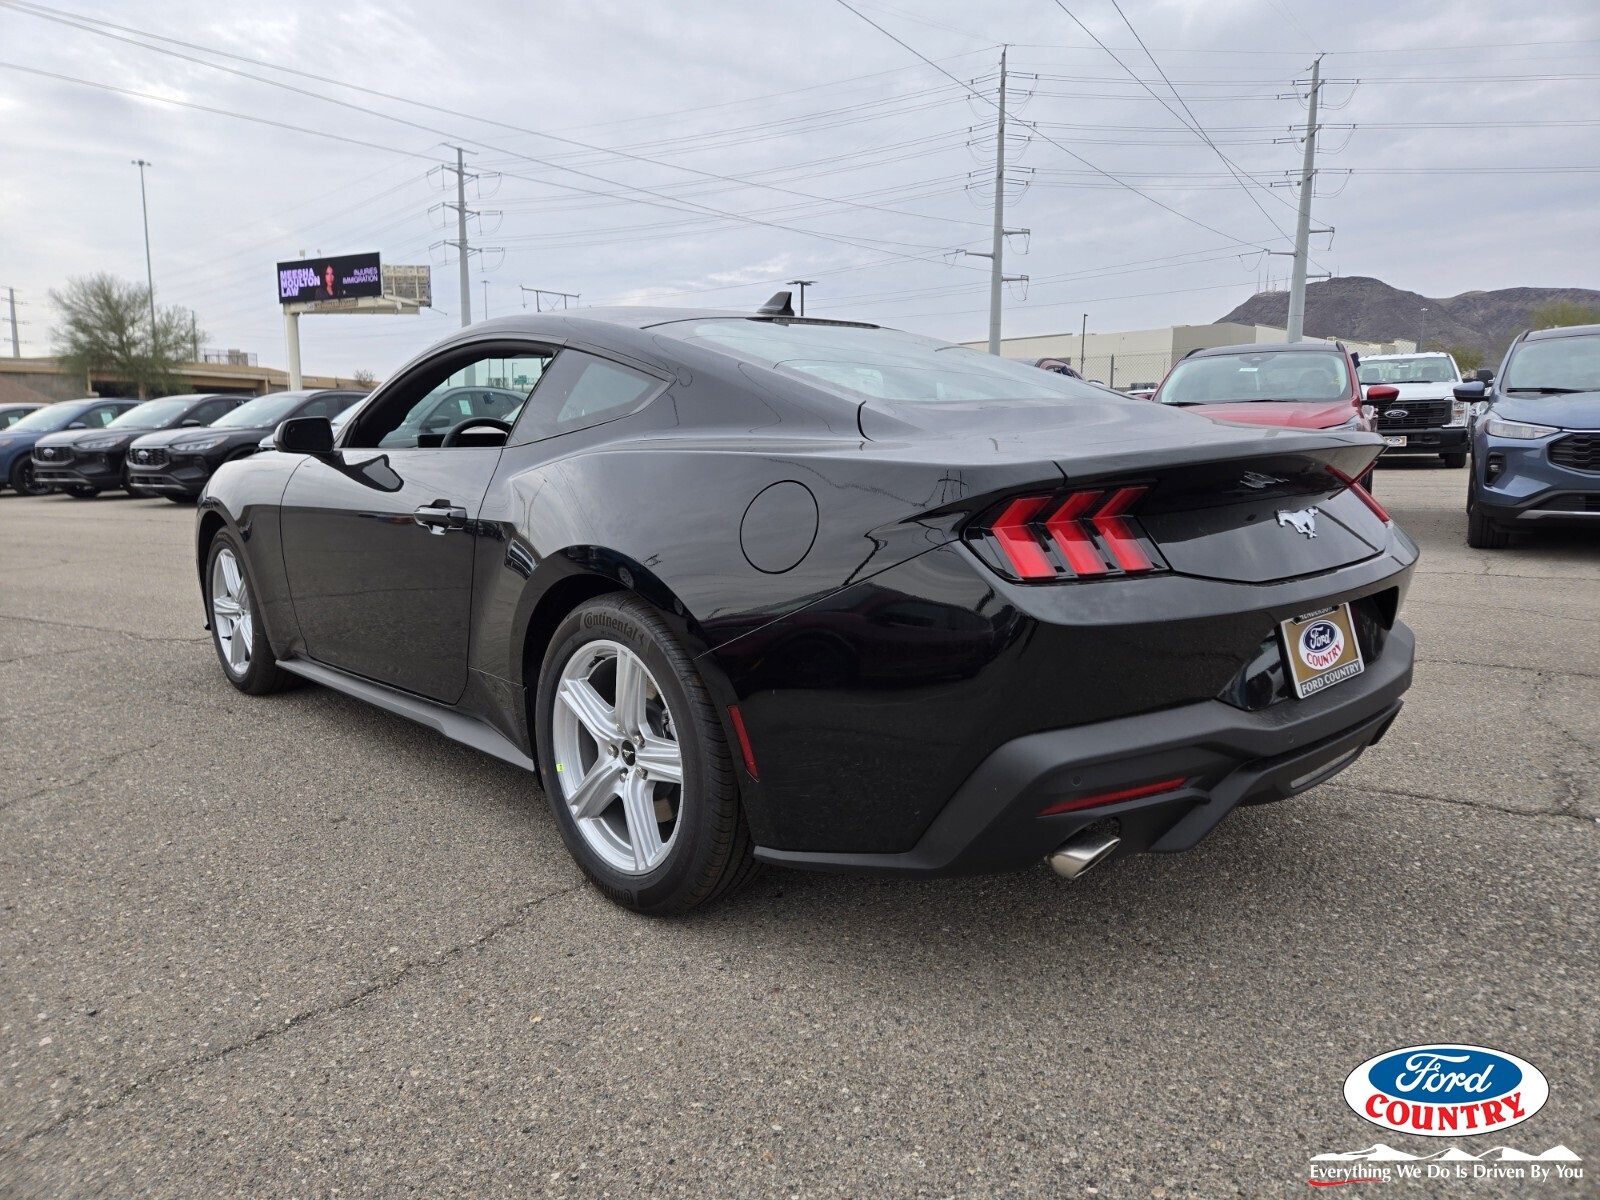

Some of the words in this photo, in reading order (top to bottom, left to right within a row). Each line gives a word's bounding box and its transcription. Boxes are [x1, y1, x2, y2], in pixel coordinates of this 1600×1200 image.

[280, 267, 314, 280] MEESHA
[281, 275, 320, 288] MOULTON
[342, 275, 378, 284] IMMIGRATION
[281, 287, 299, 297] LAW
[584, 612, 638, 640] Continental
[1310, 626, 1331, 649] Ford
[1306, 641, 1341, 667] COUNTRY
[1301, 677, 1324, 694] FORD
[1324, 661, 1360, 684] COUNTRY
